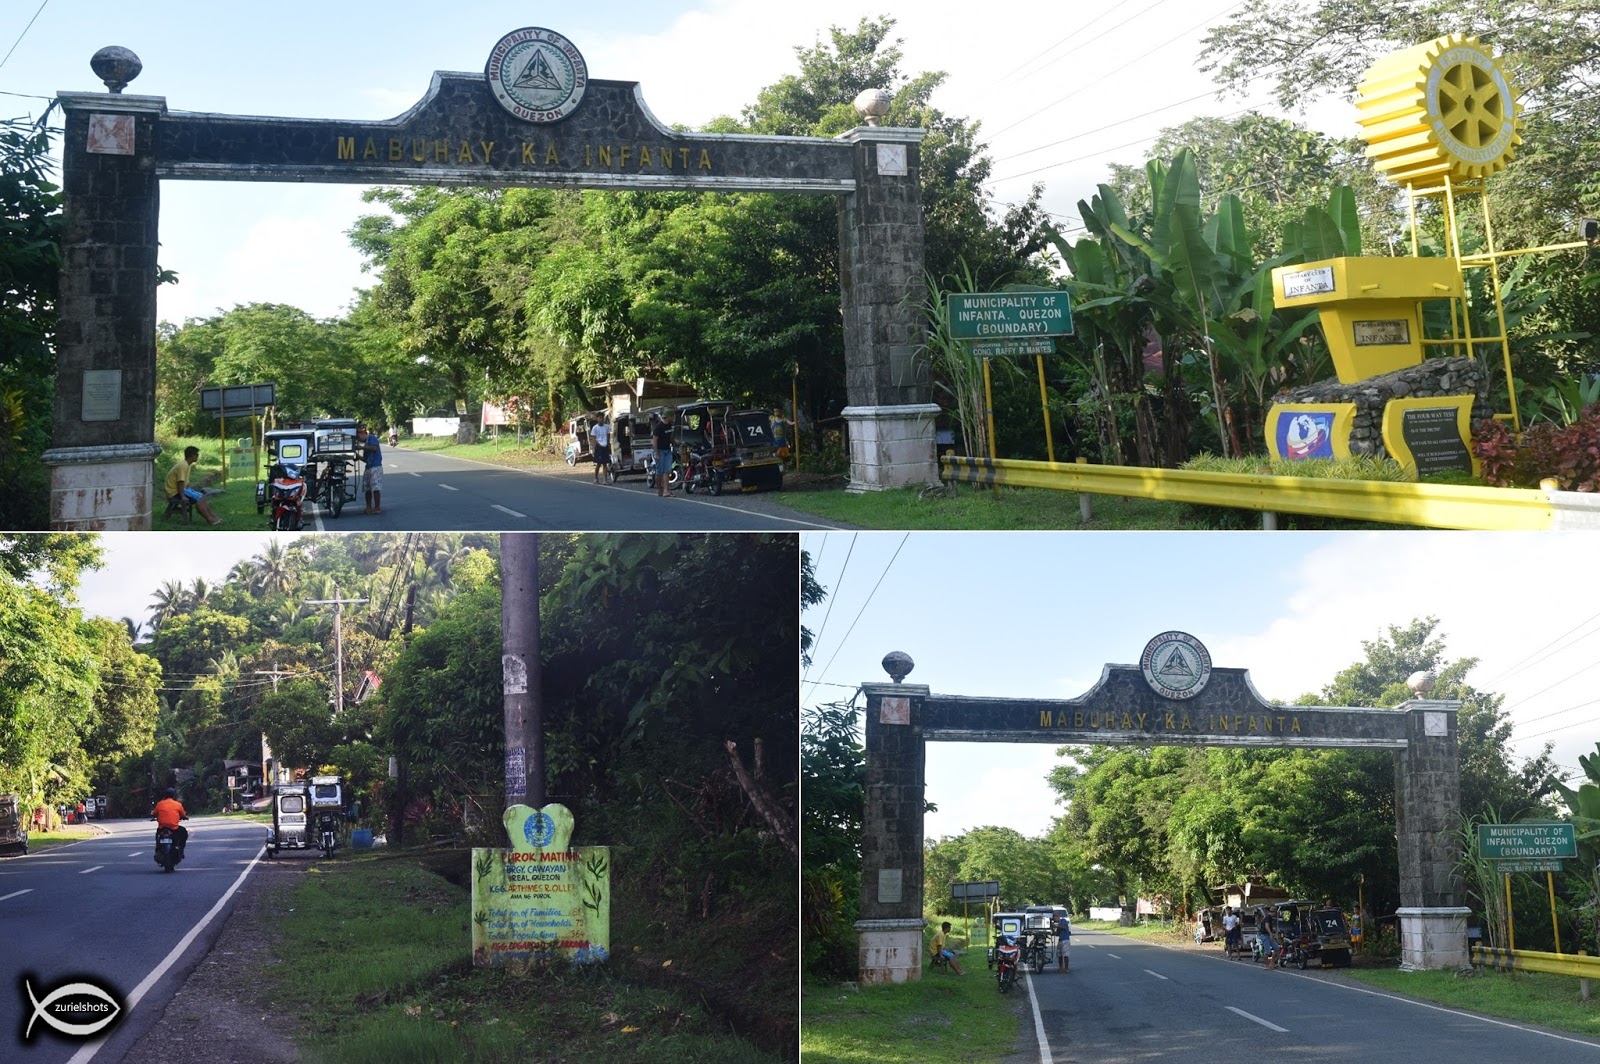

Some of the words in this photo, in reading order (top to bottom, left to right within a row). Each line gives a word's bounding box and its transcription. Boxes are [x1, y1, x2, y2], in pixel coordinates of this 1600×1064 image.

[490, 30, 542, 80] MUNICIPALITY
[547, 33, 561, 44] OF
[562, 44, 585, 88] INFANTA
[1444, 50, 1488, 66] ROTARY
[512, 106, 564, 122] QUEZON
[338, 136, 495, 164] MABUHAY
[522, 142, 560, 164] KA
[586, 144, 712, 169] INFANTA
[1290, 282, 1329, 294] INFANTA
[964, 297, 1037, 308] MUNICIPALITY
[1043, 297, 1056, 306] OF
[1020, 309, 1062, 319] QUEZON
[977, 321, 1048, 335] (BOUNDARY)
[1143, 633, 1180, 671] MUNICIPALITY
[1194, 643, 1210, 674] INFANTA
[1159, 688, 1194, 698] QUEZON
[1040, 710, 1146, 729] MABUHAY
[1165, 713, 1191, 729] KA
[1209, 714, 1301, 732] INFANTA
[1490, 828, 1548, 836] MUNICIPALITY
[1501, 846, 1557, 856] (BOUNDARY)
[502, 853, 536, 863] PUROK
[528, 865, 566, 873] CAWAYAN
